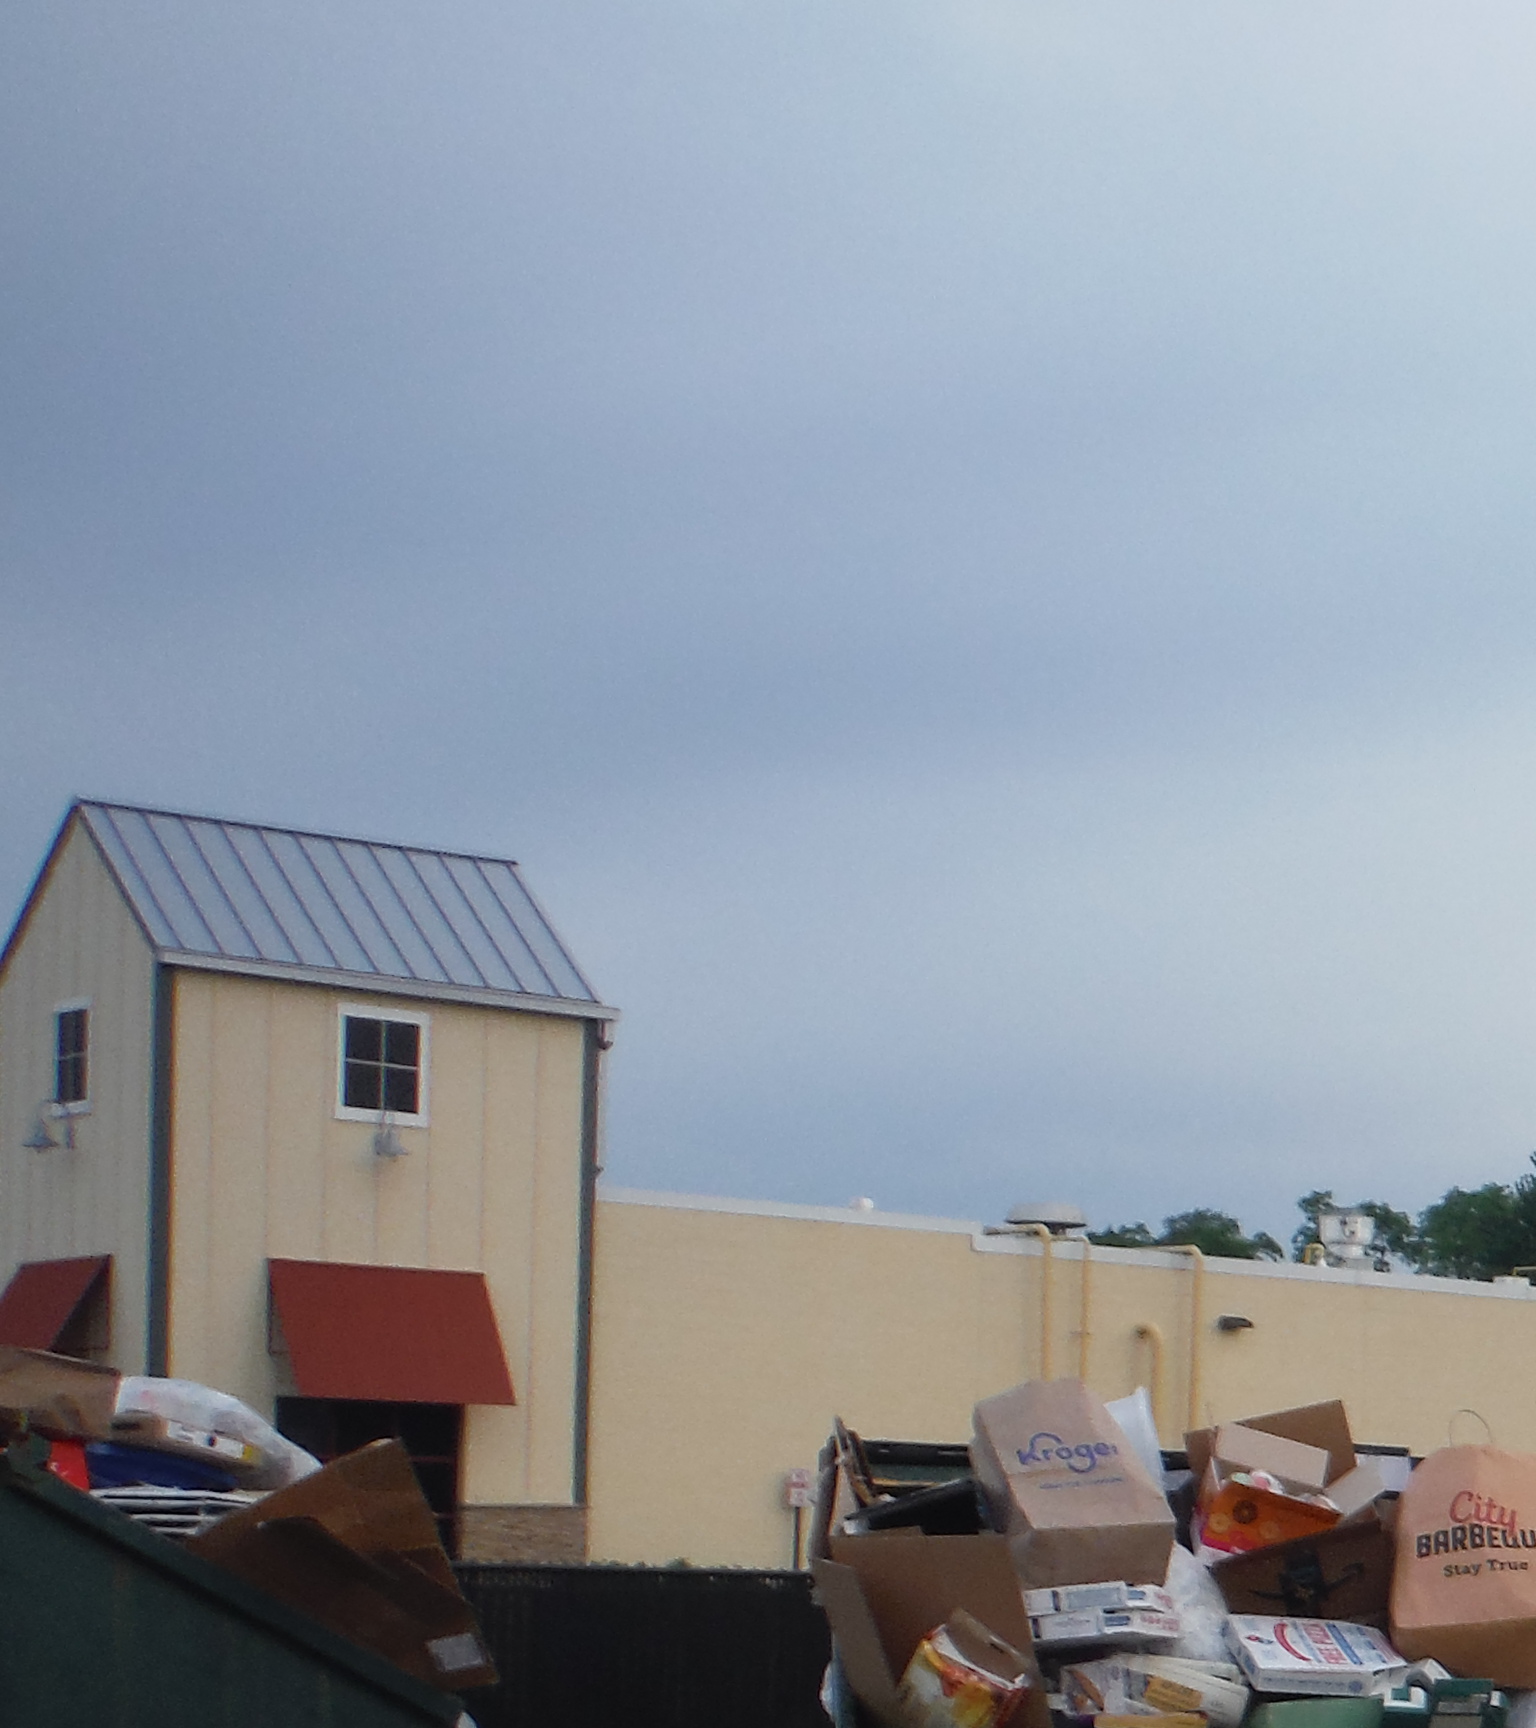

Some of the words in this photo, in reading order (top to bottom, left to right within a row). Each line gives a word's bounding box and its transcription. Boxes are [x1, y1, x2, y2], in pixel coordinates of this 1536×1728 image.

[1450, 1490, 1518, 1537] City
[1443, 1563, 1482, 1577] Stay
[1487, 1558, 1529, 1572] True
